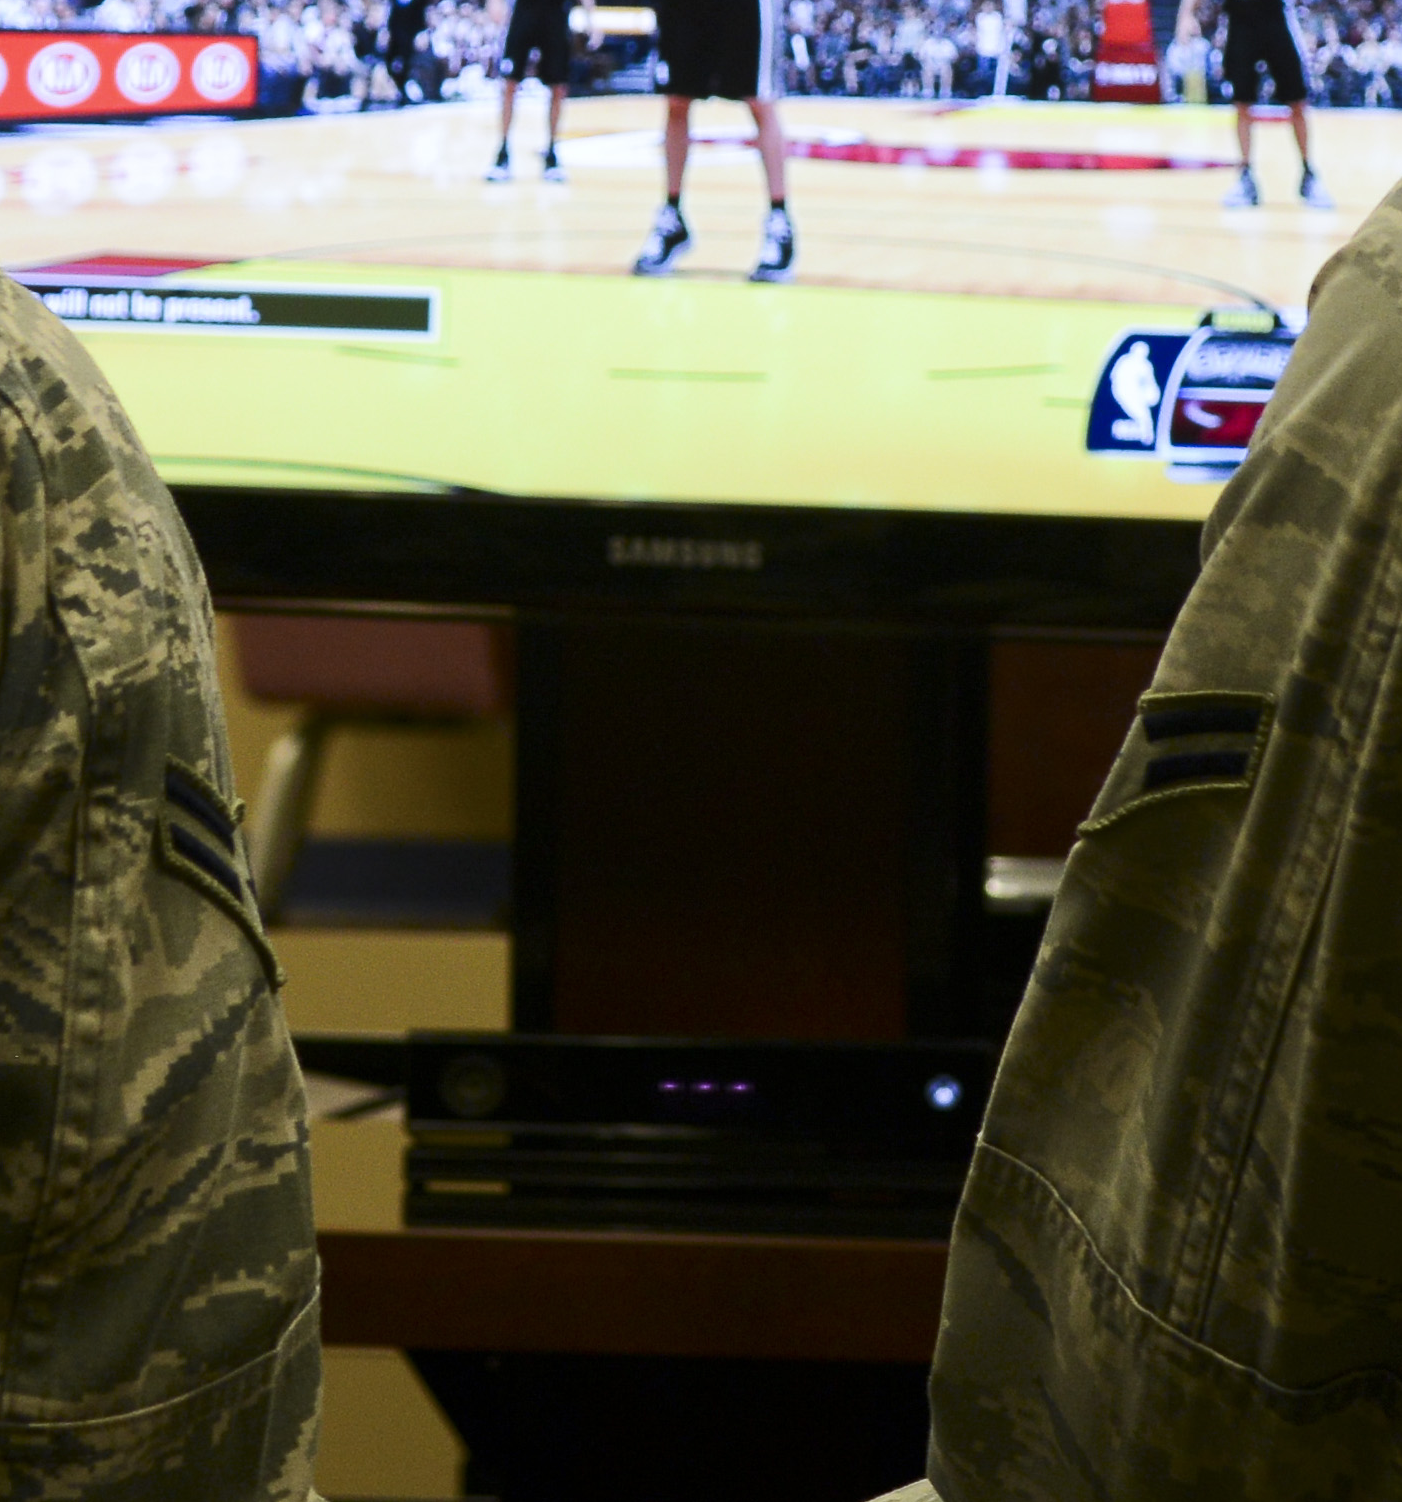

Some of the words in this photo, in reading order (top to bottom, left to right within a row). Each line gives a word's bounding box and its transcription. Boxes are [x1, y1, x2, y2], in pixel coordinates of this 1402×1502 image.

[89, 292, 128, 319] not
[131, 291, 162, 320] be
[607, 536, 763, 569] SAMSUNG
